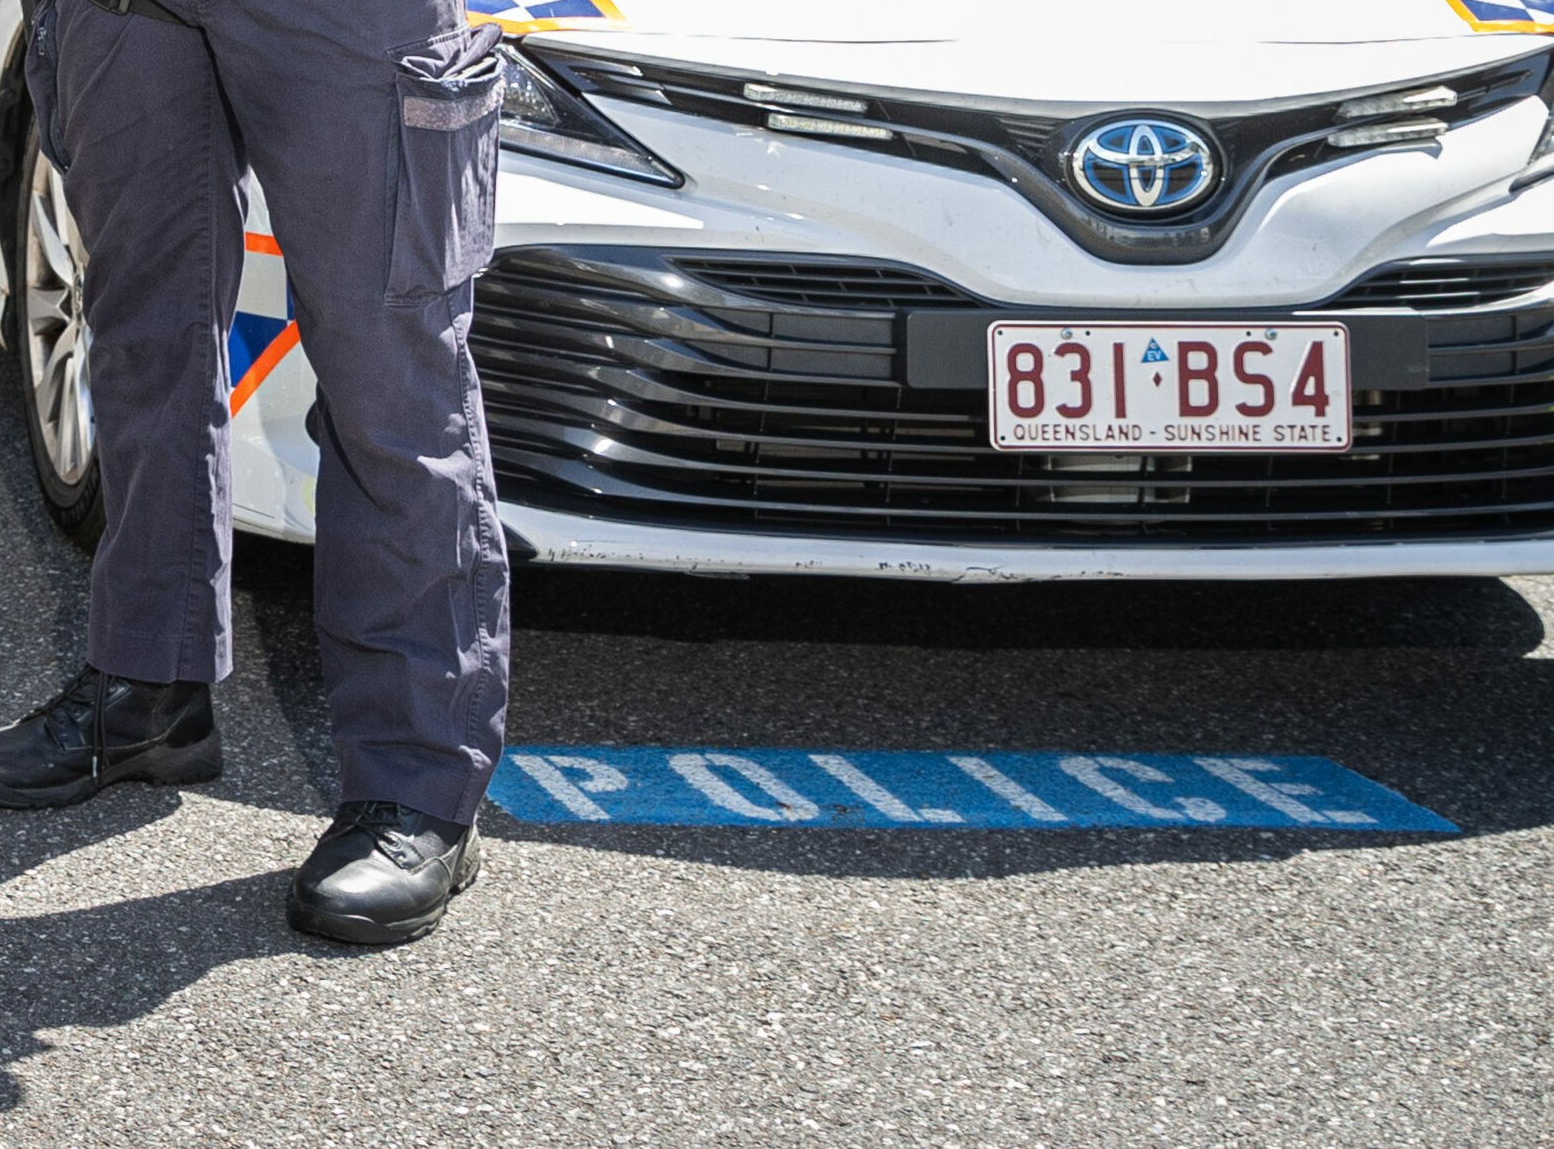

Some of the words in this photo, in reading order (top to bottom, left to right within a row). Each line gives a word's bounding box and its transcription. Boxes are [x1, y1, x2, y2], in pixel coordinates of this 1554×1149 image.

[1006, 340, 1127, 420] 831
[1177, 339, 1330, 418] BS4
[1013, 423, 1143, 442] QUEENSLAND
[1164, 424, 1262, 442] SUNSHINE
[1274, 425, 1331, 442] STATE
[508, 754, 1379, 825] POLICE
